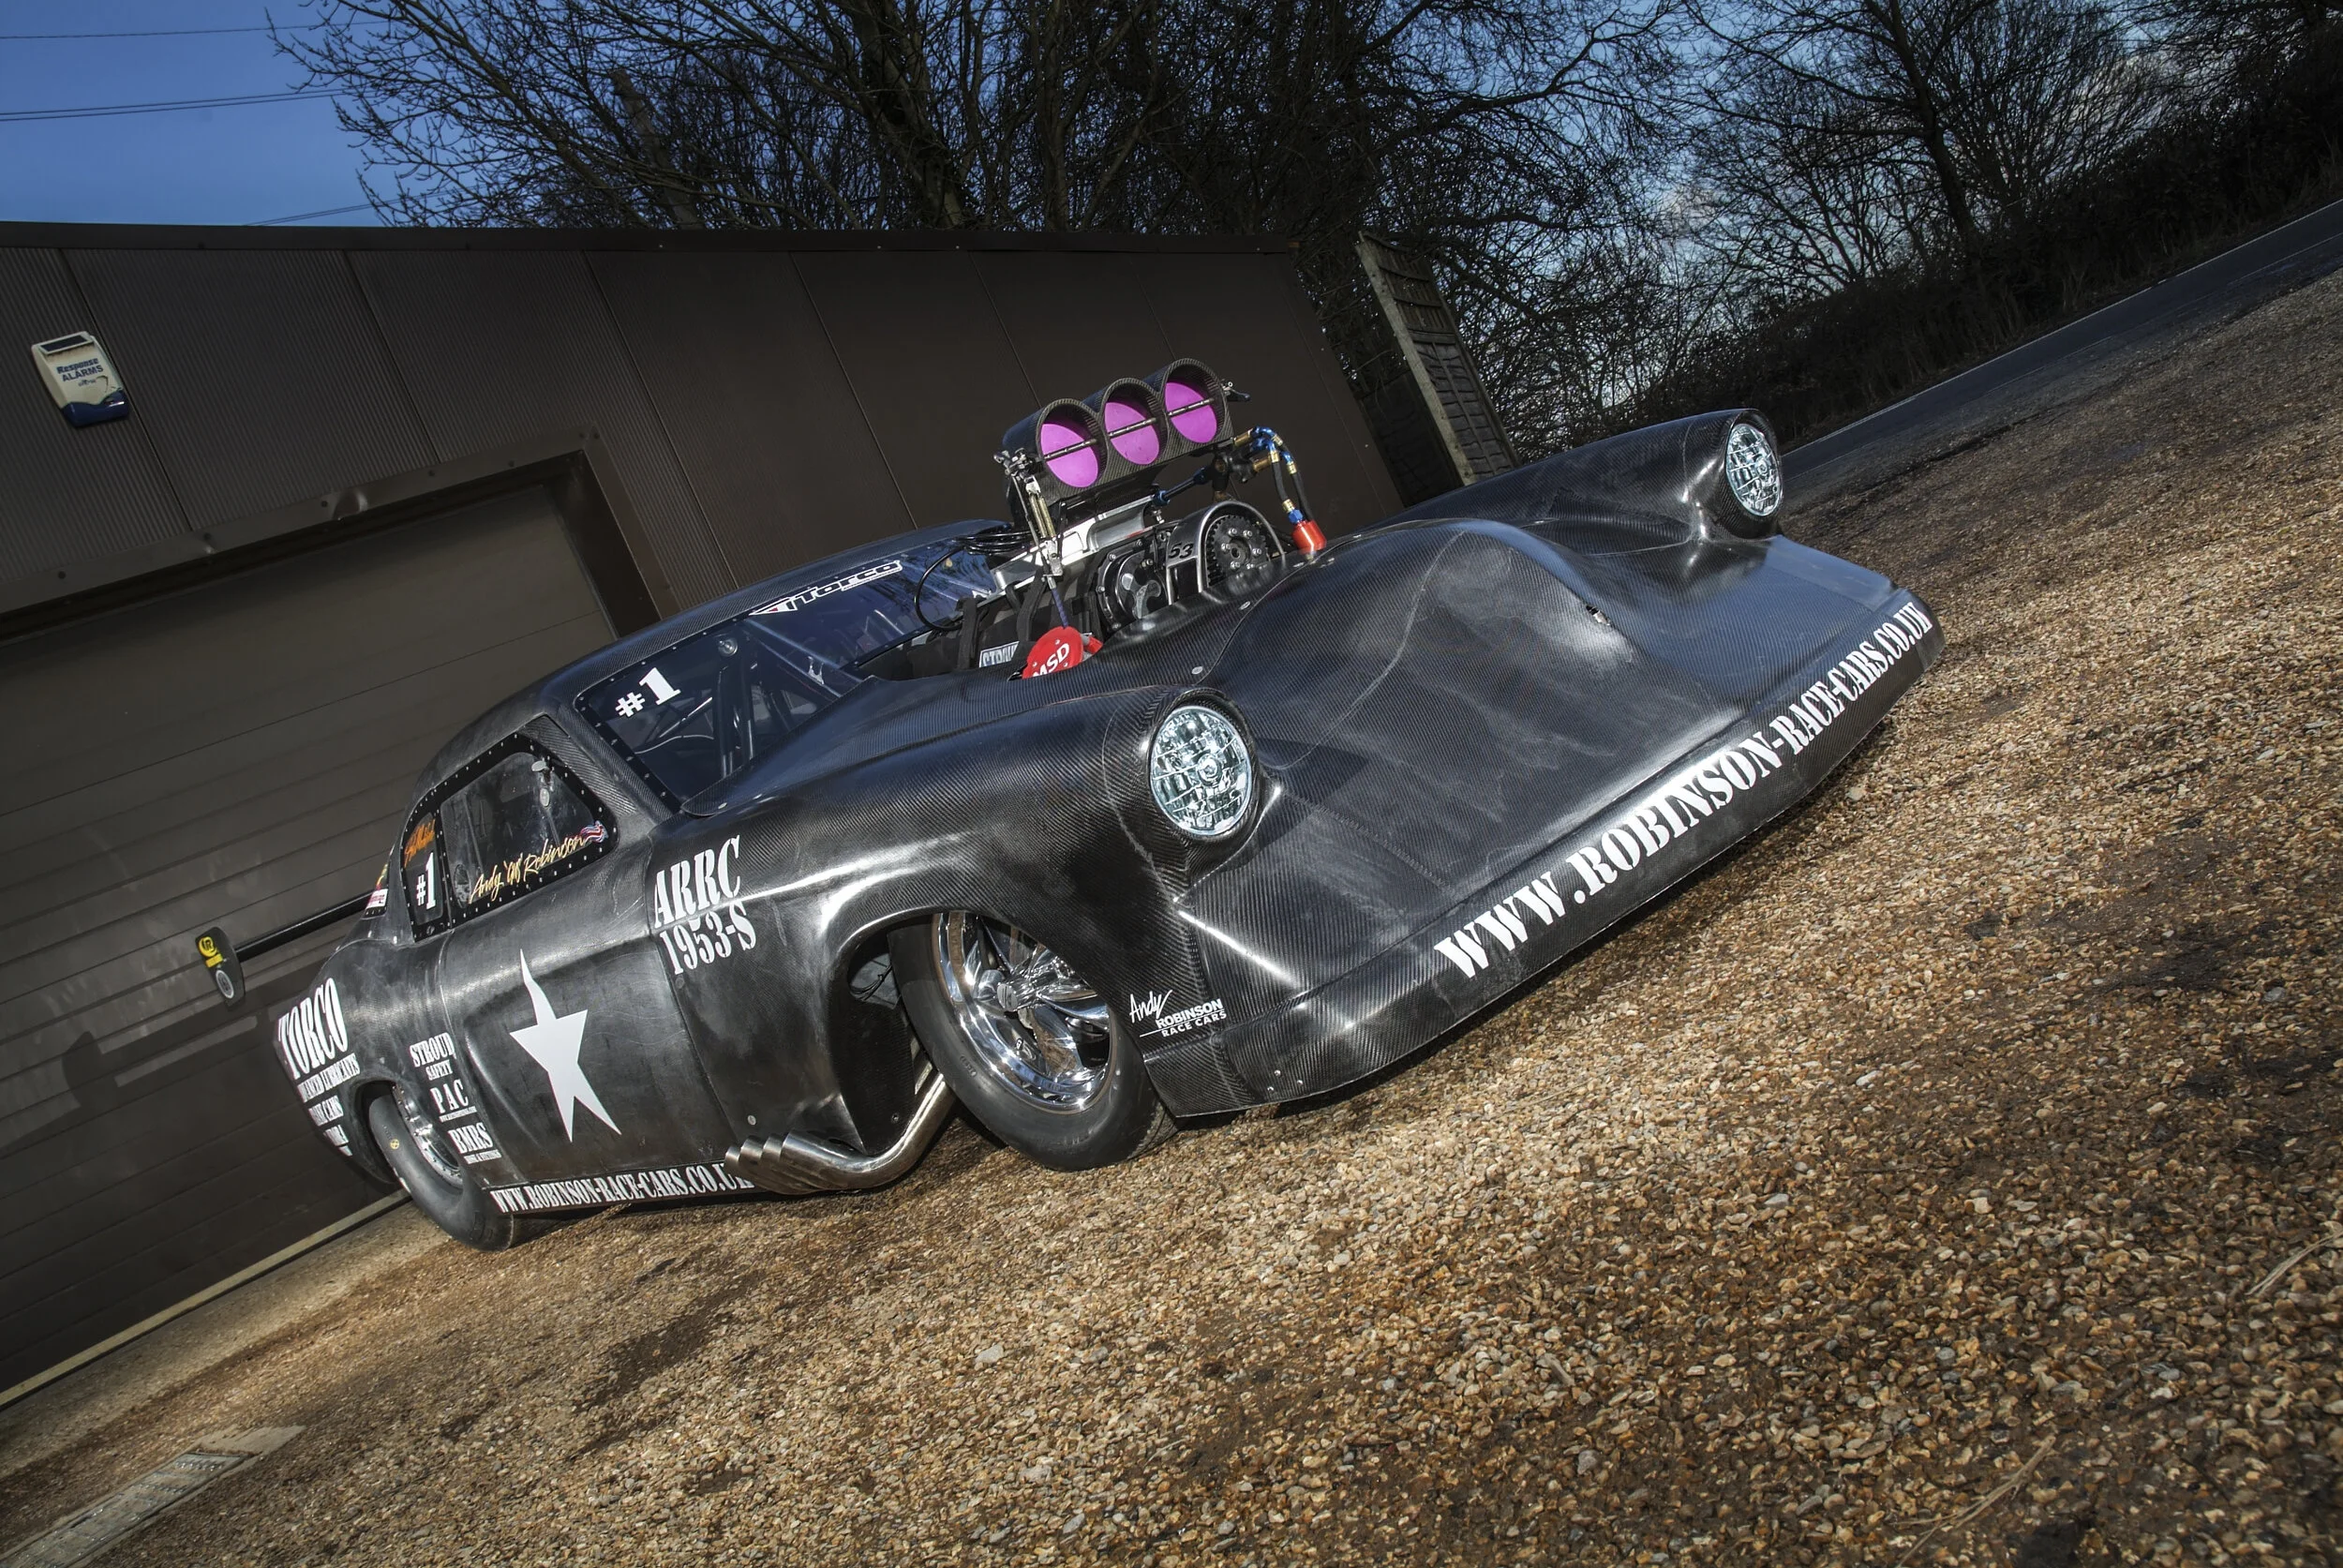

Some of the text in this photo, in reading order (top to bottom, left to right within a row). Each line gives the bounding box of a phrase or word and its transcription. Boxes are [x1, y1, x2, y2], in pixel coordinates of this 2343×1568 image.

[56, 358, 99, 375] Response
[62, 365, 104, 381] ALARMS
[1168, 542, 1194, 559] 53
[615, 666, 681, 719] #1
[416, 852, 437, 909] #1
[468, 864, 504, 904] Andy
[523, 835, 586, 882] Robinson
[654, 834, 740, 929] ARRC
[659, 901, 756, 975] 1953-S
[1129, 989, 1173, 1023] Andy
[1156, 998, 1224, 1029] ROBINSON
[278, 978, 349, 1080] TORCO
[1161, 1010, 1228, 1038] RACE CARS
[410, 1032, 457, 1068] STROUD
[425, 1059, 454, 1081] SAFETY
[448, 1122, 494, 1154] BMRS
